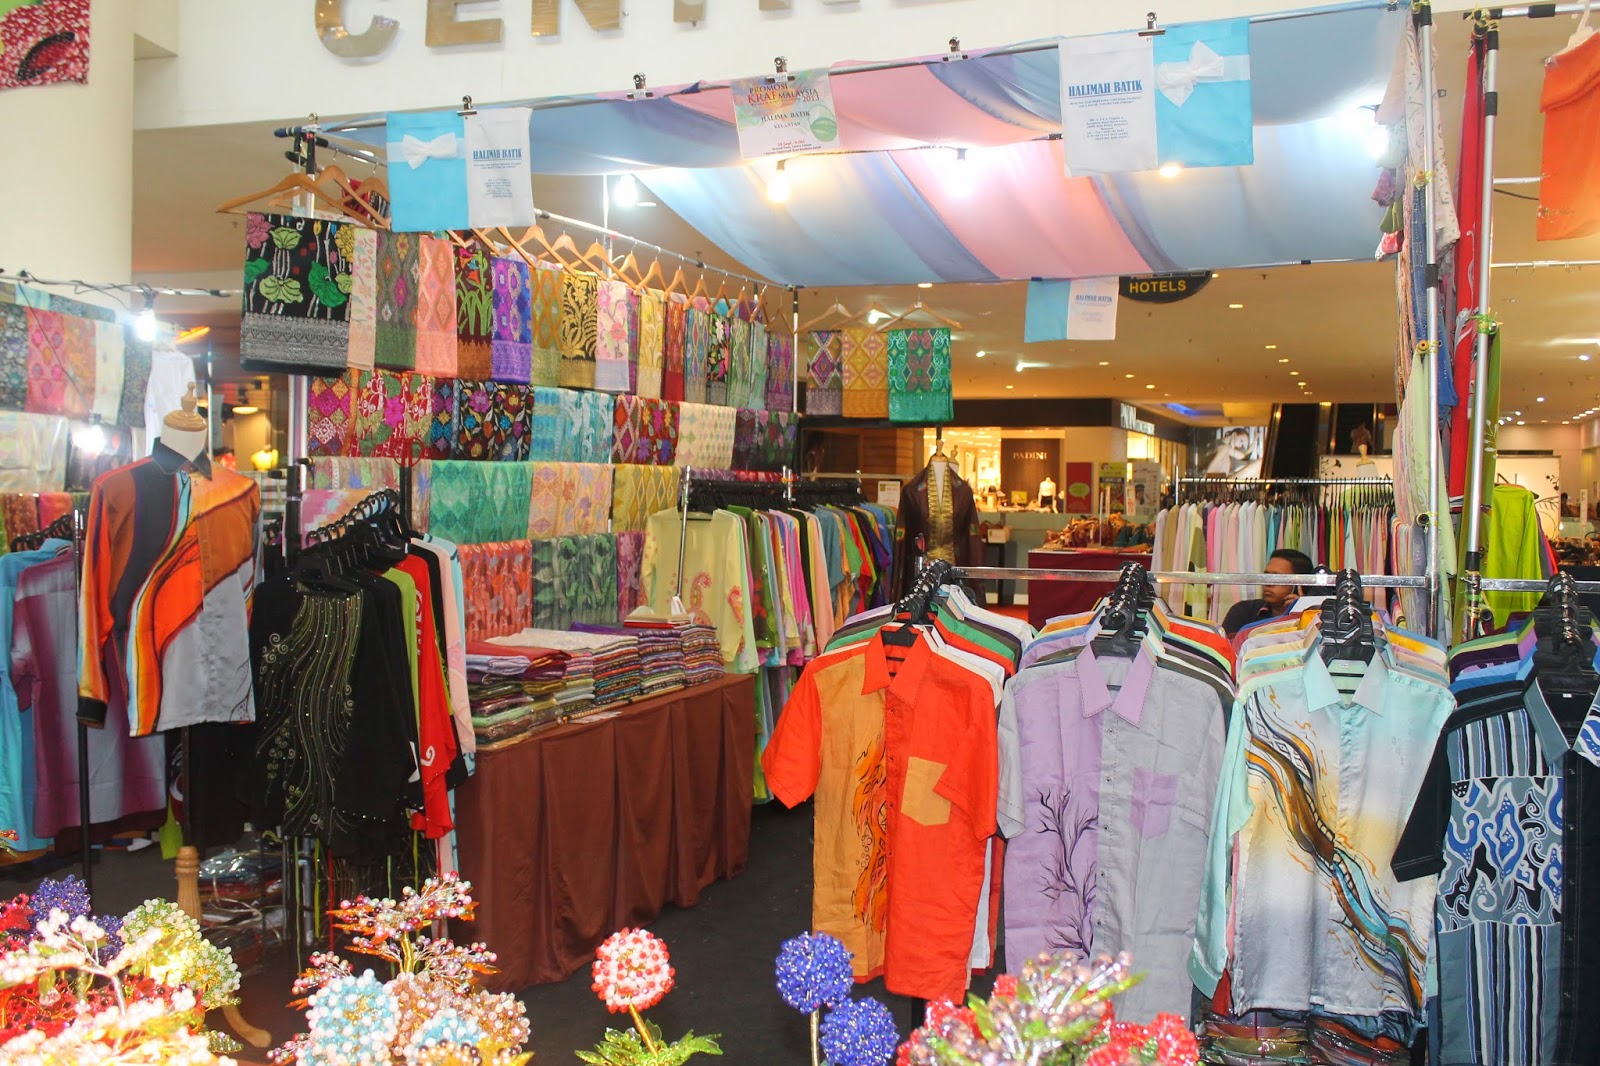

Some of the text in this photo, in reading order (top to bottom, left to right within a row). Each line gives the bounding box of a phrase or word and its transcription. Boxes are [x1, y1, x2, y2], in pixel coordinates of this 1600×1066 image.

[749, 83, 787, 94] PROMOSI
[1069, 80, 1142, 96] HALIMAH BATIK
[747, 92, 776, 103] KRAF
[778, 88, 818, 99] MALAYSIA
[803, 94, 819, 102] 2013
[473, 148, 521, 159] HALIMAH BATIK
[1129, 280, 1186, 293] HOTELS
[1012, 451, 1048, 460] PADINI
